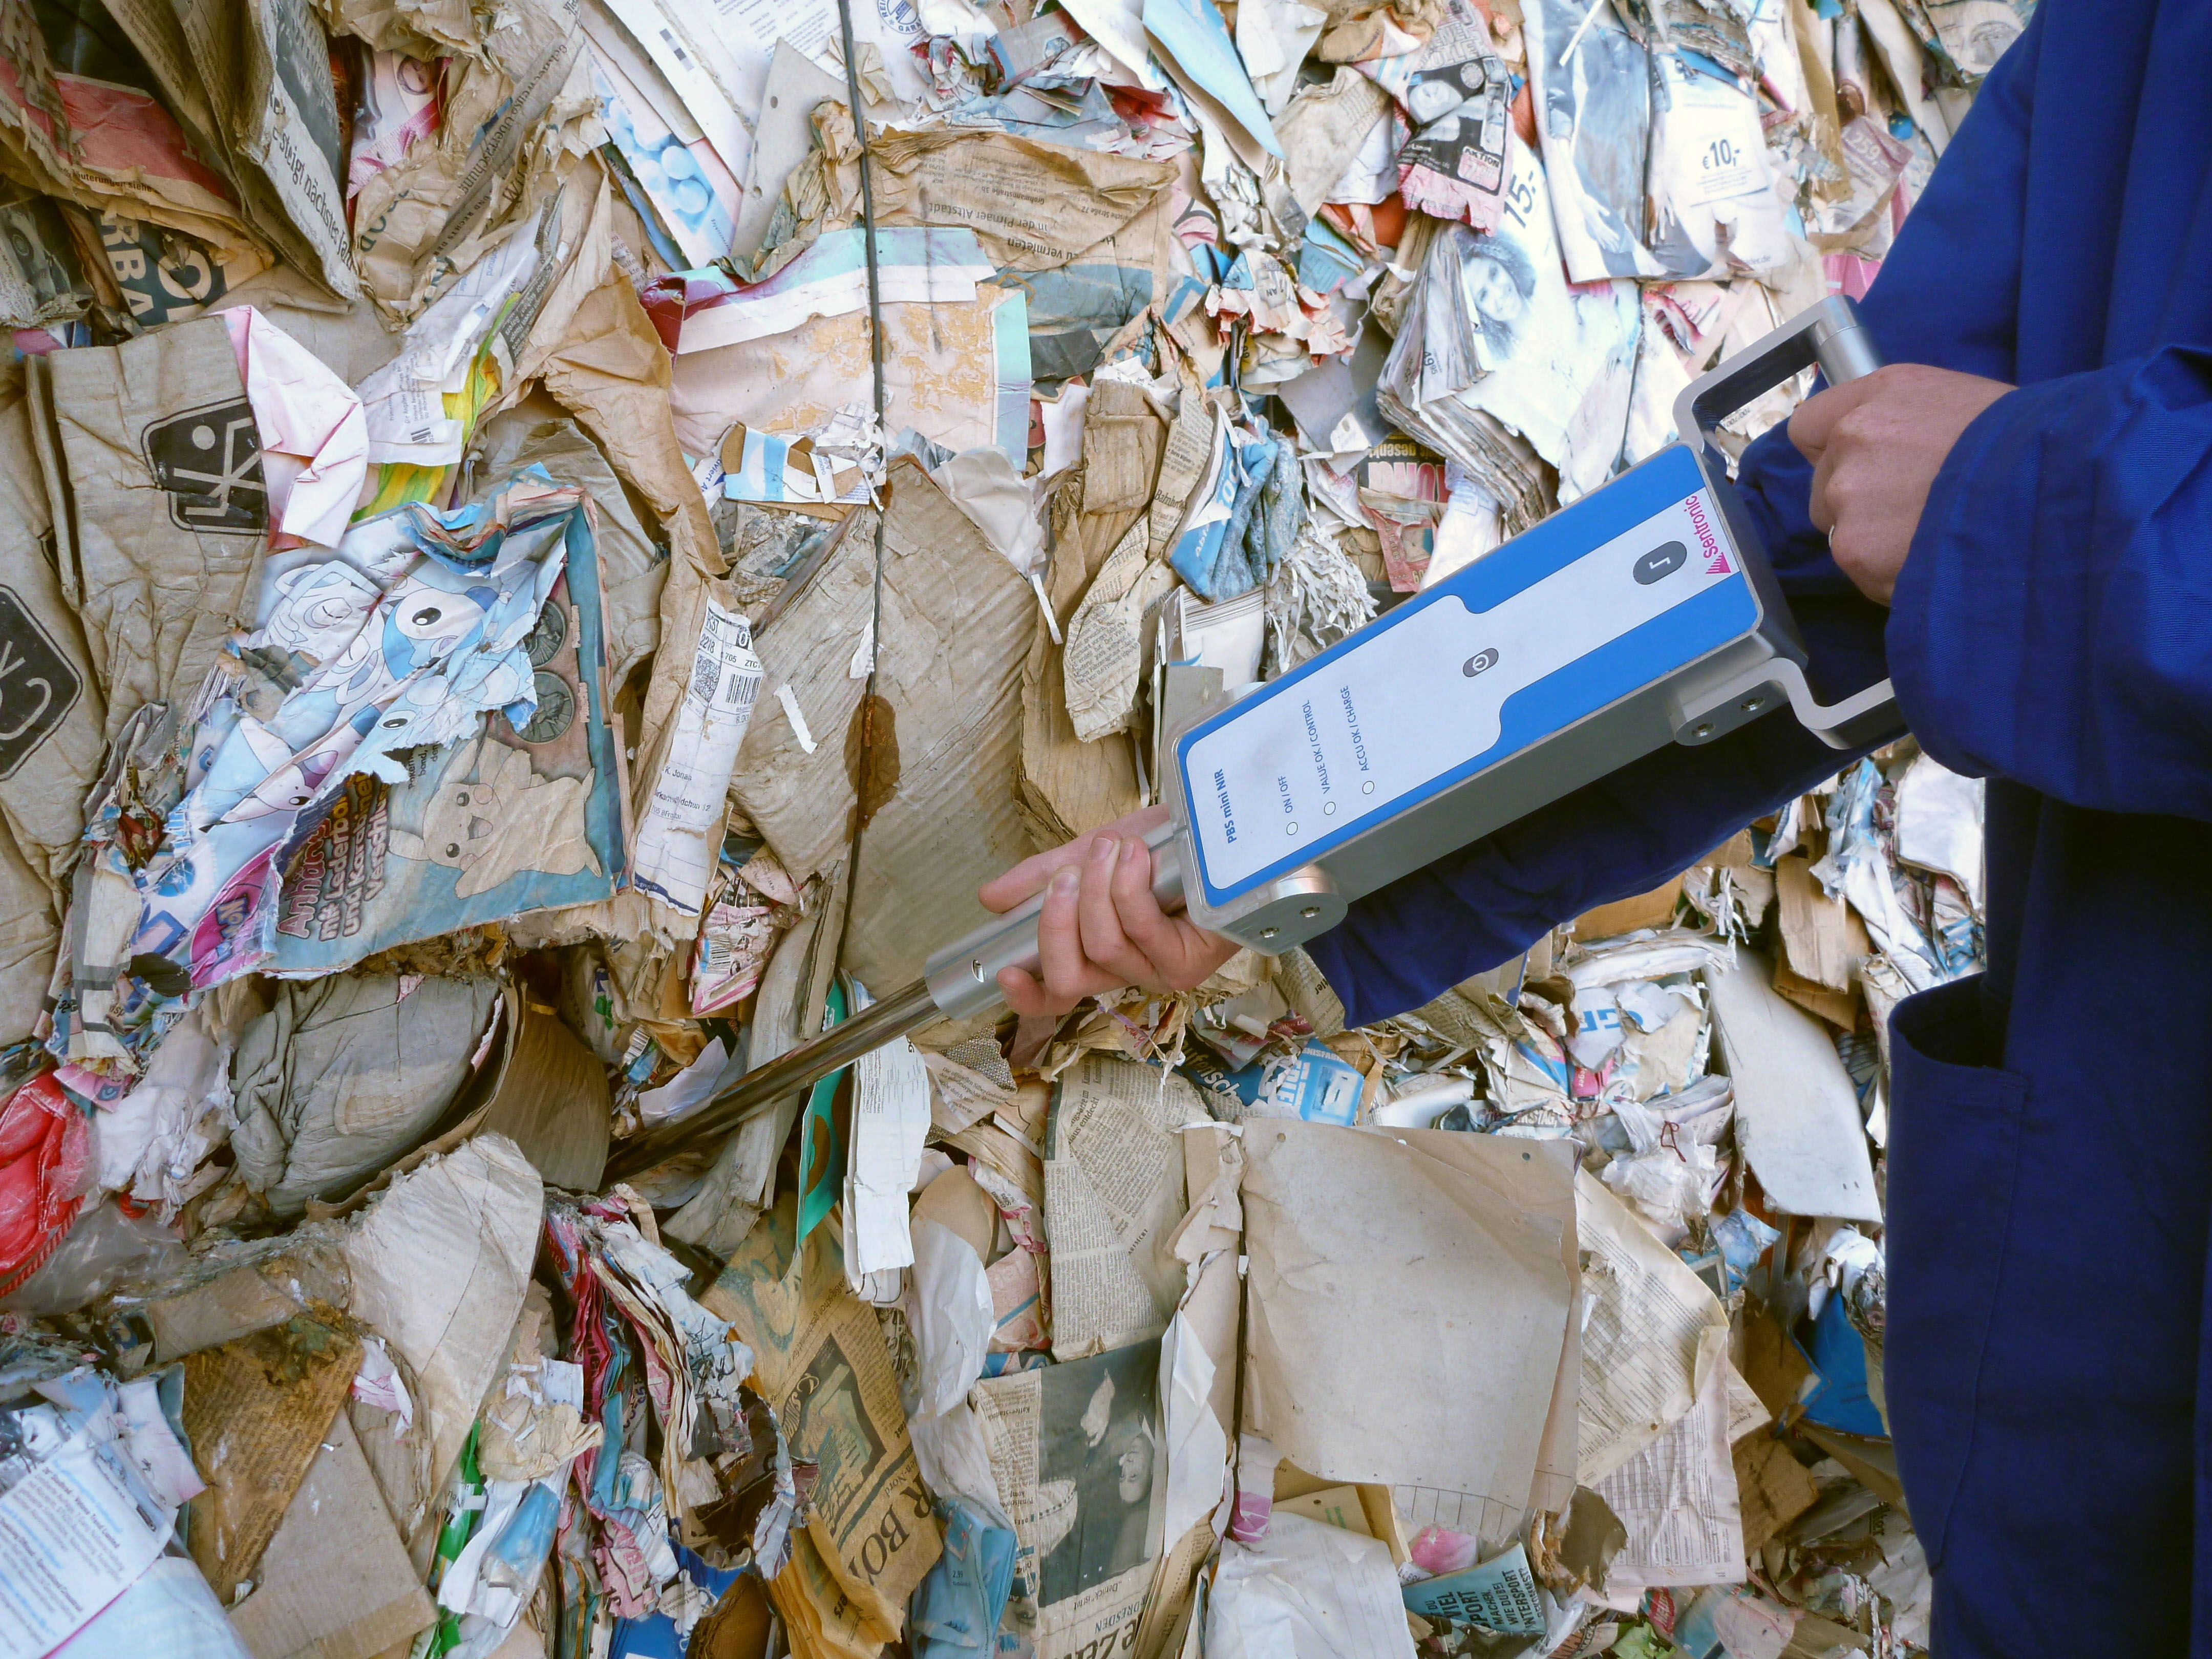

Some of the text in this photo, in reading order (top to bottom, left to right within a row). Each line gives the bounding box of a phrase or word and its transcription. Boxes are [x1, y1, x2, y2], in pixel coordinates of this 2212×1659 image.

[1465, 147, 1500, 168] AKTION
[280, 131, 306, 185] steigt
[304, 173, 338, 246] nächstes
[990, 188, 1046, 205] Grohmannstraße
[927, 202, 1048, 232] in der Pirnaer Altstadt
[1006, 237, 1065, 259] vermieten
[1153, 488, 1189, 512] Bahnhof
[1684, 495, 1720, 559] Sentronic
[1340, 685, 1356, 724] CHARGE
[1302, 699, 1318, 742] CONTROL
[1351, 730, 1362, 744] OK
[1313, 748, 1323, 762] OK
[1355, 745, 1370, 771] ACCU
[672, 769, 693, 781] Jonas
[1278, 775, 1289, 792] OFF
[1316, 762, 1330, 794] VALUE
[1214, 768, 1237, 844] PBS mini NIR
[1283, 799, 1293, 814] ON
[315, 900, 342, 942] mit
[342, 882, 364, 937] und
[942, 1066, 952, 1074] Die
[950, 1070, 975, 1086] offiziellen
[949, 1087, 965, 1099] durch
[1078, 1096, 1101, 1129] entdeckt
[1425, 1600, 1438, 1610] DU
[1437, 1591, 1462, 1618] VIEL
[1482, 1589, 1505, 1625] MACHEN,
[1499, 1594, 1512, 1607] DU
[1501, 1569, 1537, 1628] INTERSPORT
[1094, 1600, 1141, 1634] DRESDEN
[1504, 1607, 1519, 1626] WIE
